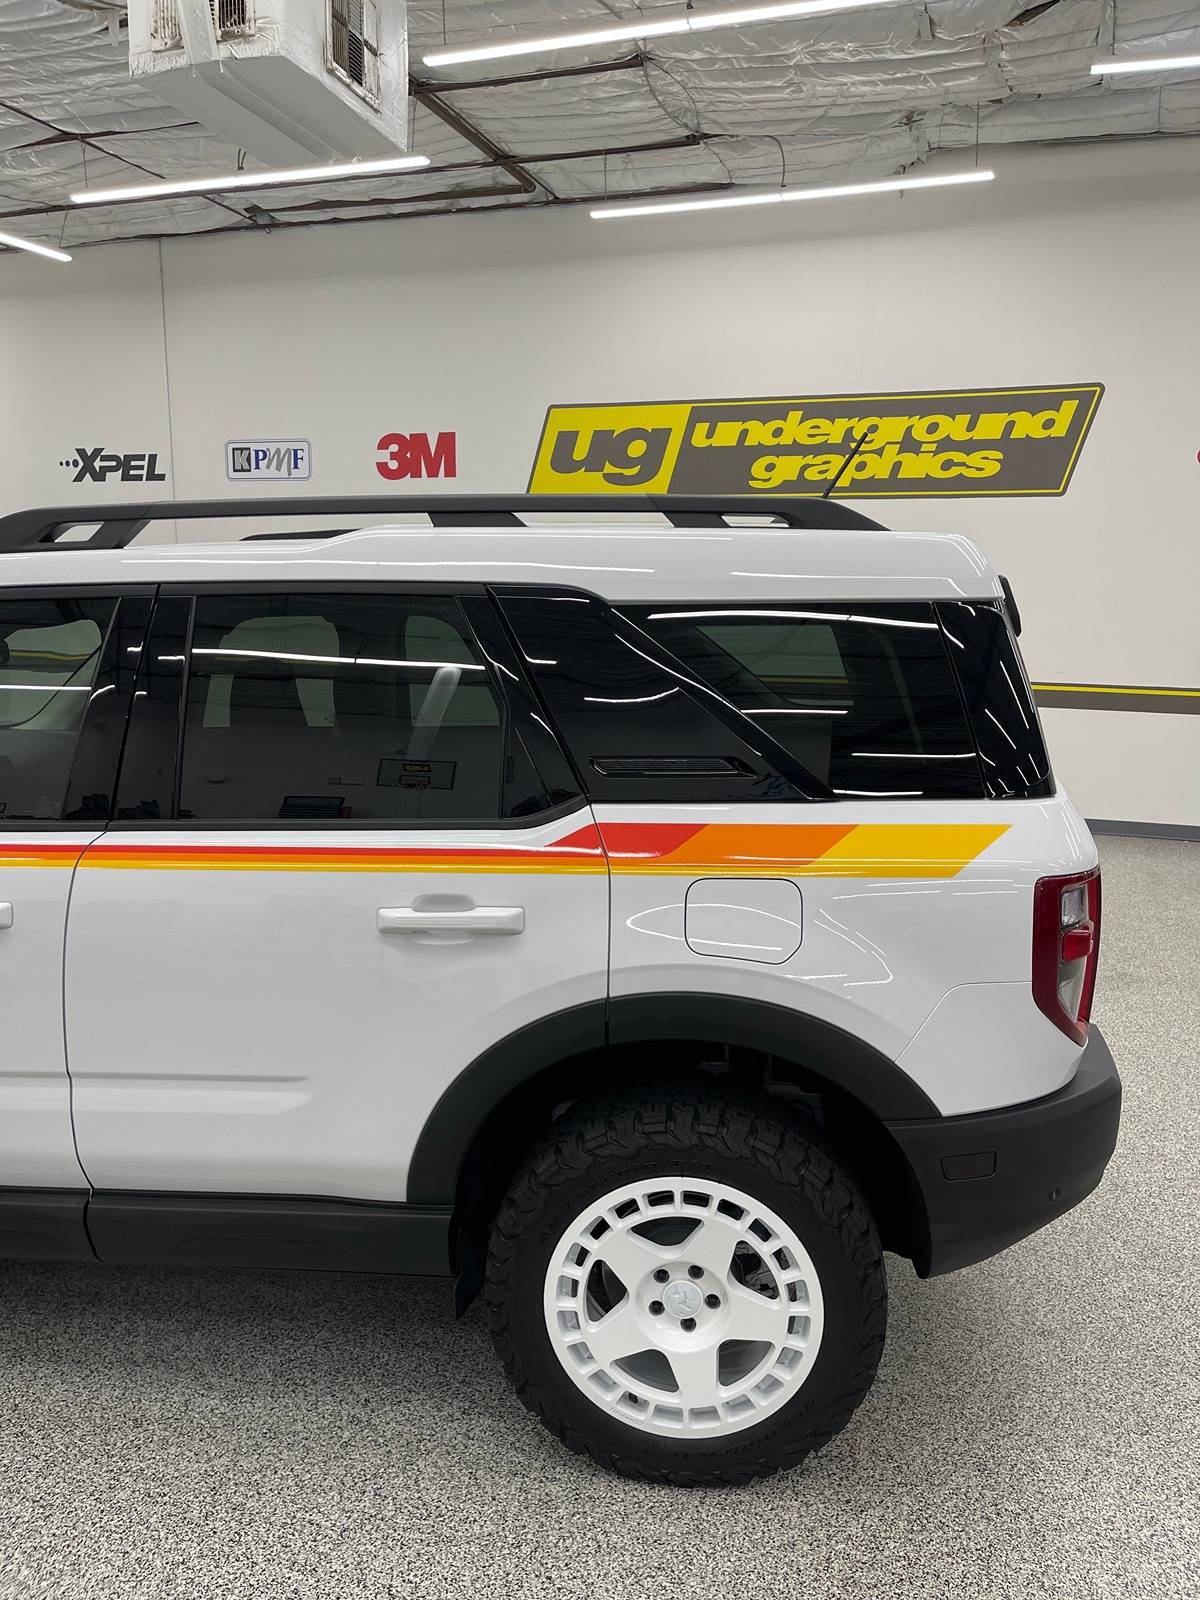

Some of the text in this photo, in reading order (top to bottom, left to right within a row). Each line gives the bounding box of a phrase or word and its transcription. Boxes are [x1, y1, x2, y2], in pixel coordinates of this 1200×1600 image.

[691, 400, 1079, 451] underground
[72, 447, 166, 483] XPEL
[232, 446, 304, 477] KPMF
[376, 431, 456, 480] 3M
[550, 427, 673, 487] ug
[749, 443, 1004, 489] graphics
